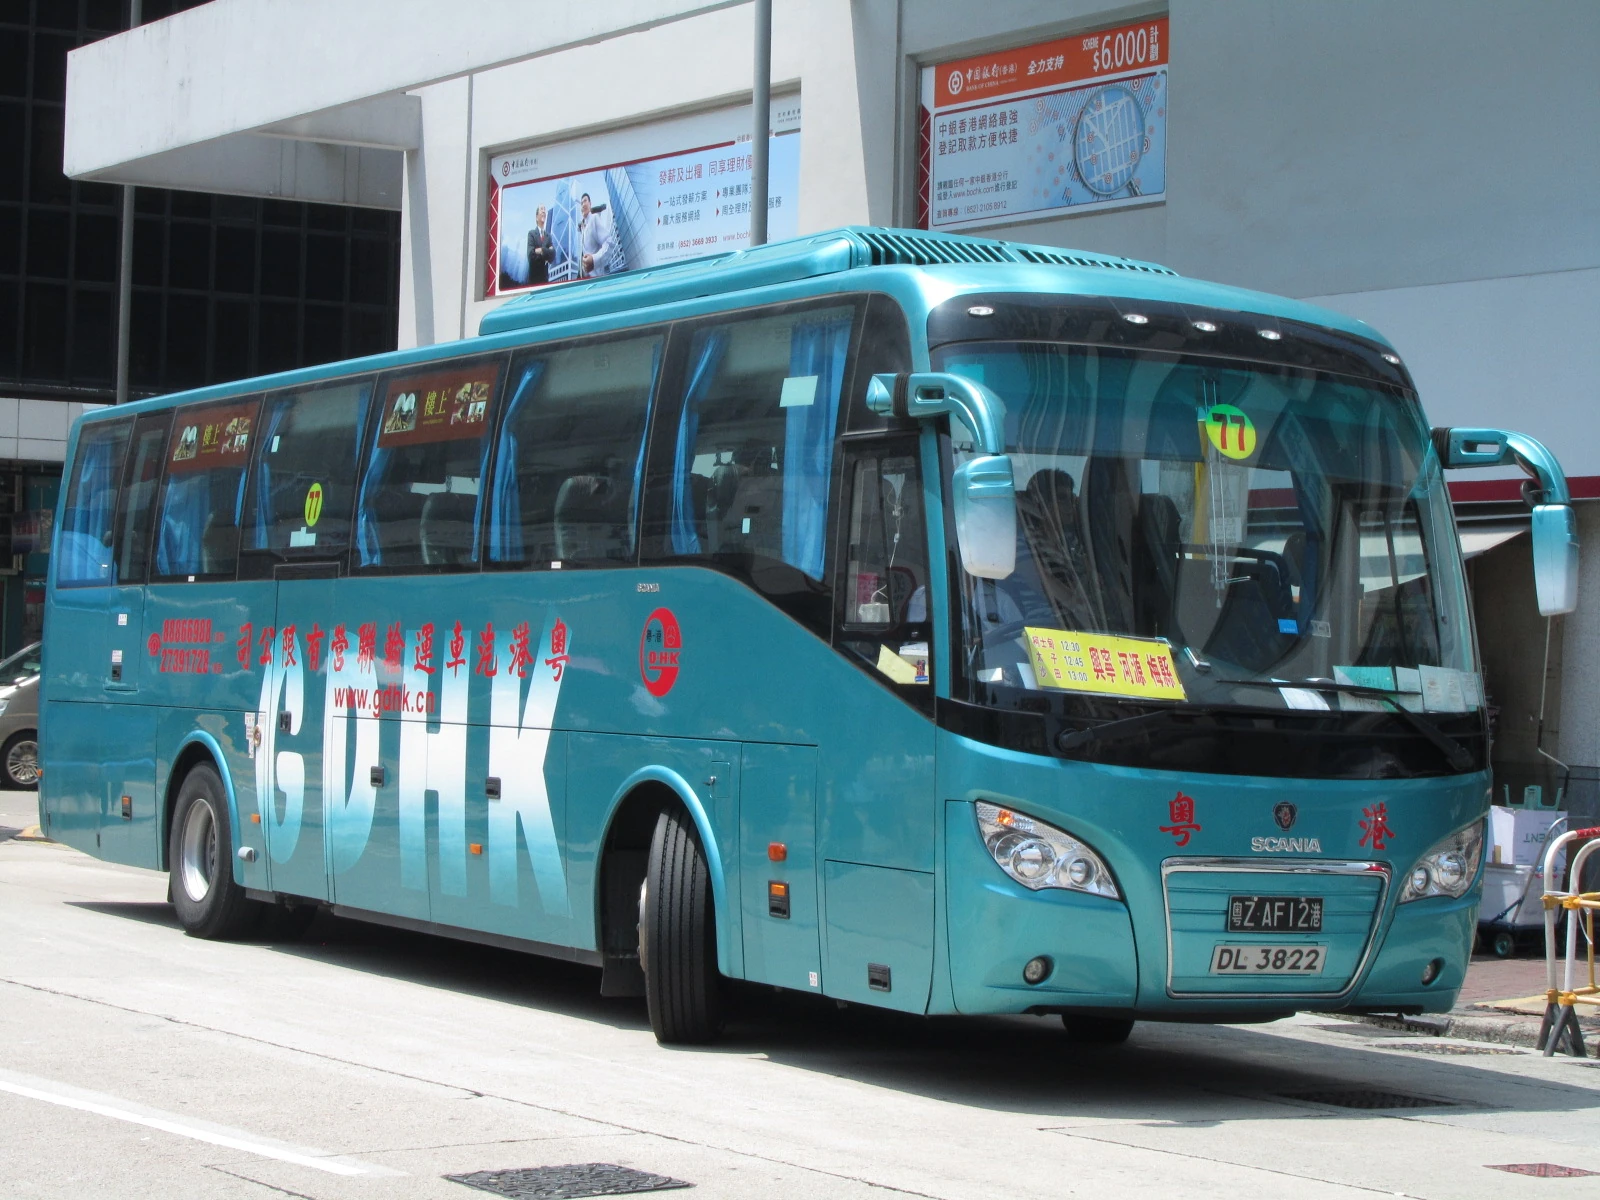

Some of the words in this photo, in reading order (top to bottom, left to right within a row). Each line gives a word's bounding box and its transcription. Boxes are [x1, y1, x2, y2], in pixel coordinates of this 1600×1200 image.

[1082, 36, 1099, 51] SCHEME
[1093, 28, 1147, 73] $6,000
[1149, 25, 1159, 61] 計劃
[1027, 54, 1065, 75] 全力支持
[938, 109, 1018, 138] 中銀香港網絡最強
[938, 128, 1018, 156] 登記取款方便快捷
[659, 163, 703, 186] 發薪及出糧
[663, 190, 708, 208] 一站式發薪方案
[1212, 412, 1246, 452] 77
[308, 490, 321, 521] 77
[1060, 640, 1080, 652] 12:30
[1063, 655, 1084, 668] 12:45
[1117, 651, 1147, 687] 河源
[1067, 670, 1088, 682] 13:00
[334, 682, 435, 718] www.gdhk.cn
[1358, 801, 1396, 851] 港
[1250, 836, 1322, 853] SCANIA
[1216, 948, 1248, 970] DL
[1255, 948, 1320, 971] 3822
